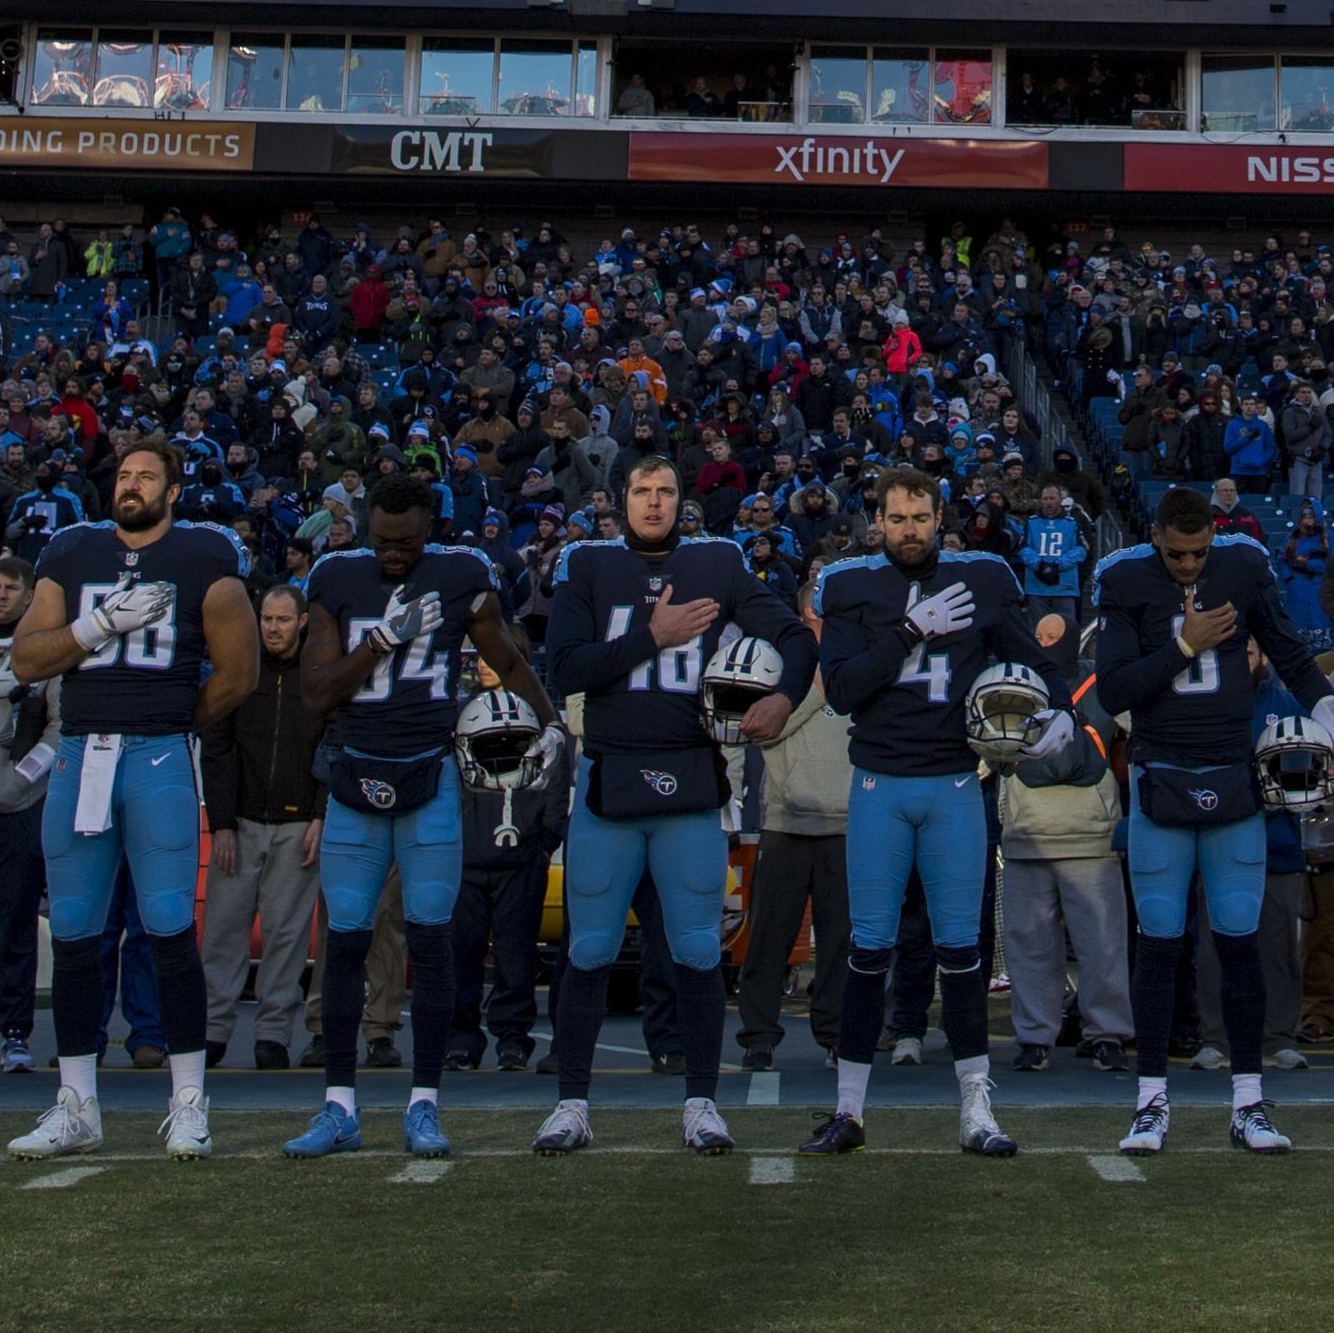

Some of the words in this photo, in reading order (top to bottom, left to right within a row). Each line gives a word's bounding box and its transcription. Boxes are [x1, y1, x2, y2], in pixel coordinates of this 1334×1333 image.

[77, 131, 240, 158] PRODUCTS
[390, 130, 493, 172] CMT
[774, 138, 906, 183] xfinity
[1038, 531, 1063, 558] 12
[643, 596, 660, 604] TITA
[896, 638, 952, 704] 4
